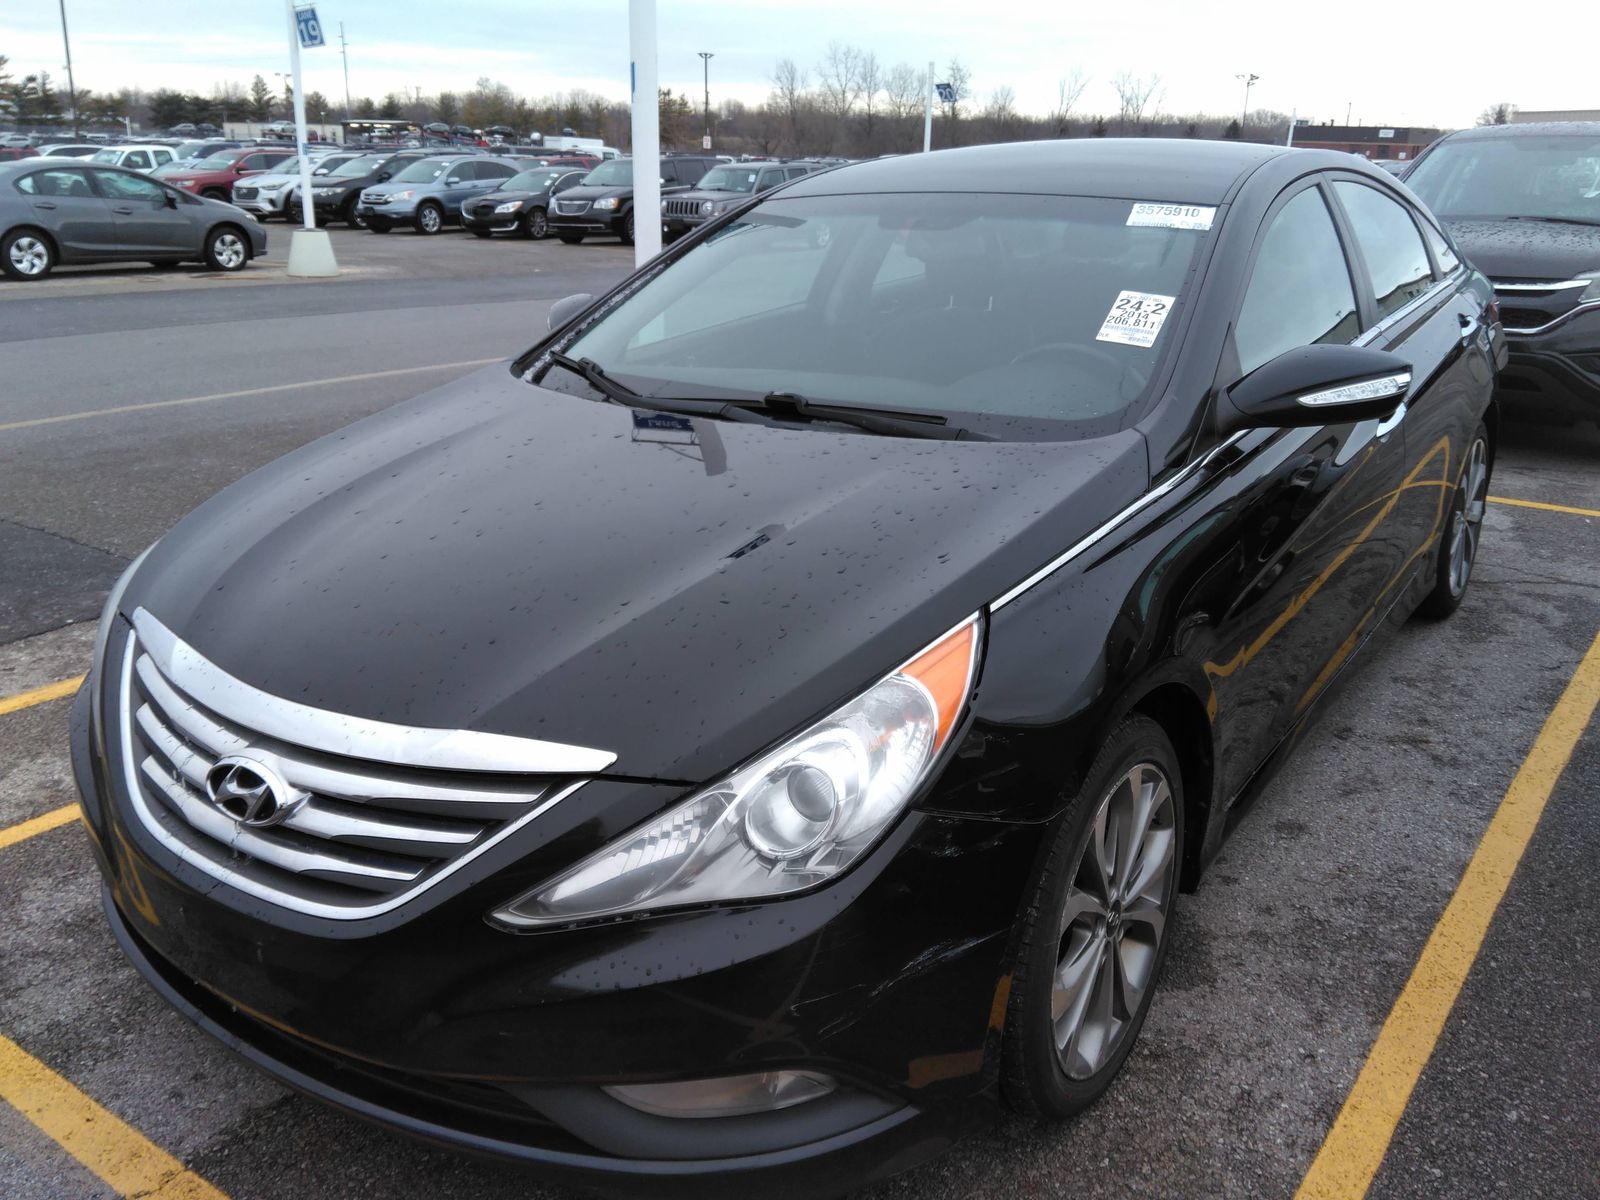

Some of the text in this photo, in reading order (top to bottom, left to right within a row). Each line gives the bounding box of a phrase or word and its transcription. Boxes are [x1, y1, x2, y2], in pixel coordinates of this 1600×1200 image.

[299, 20, 320, 46] 19
[938, 88, 956, 102] 20
[1136, 205, 1200, 218] 3575910
[1106, 315, 1155, 329] 206,811
[1120, 310, 1150, 320] 2014
